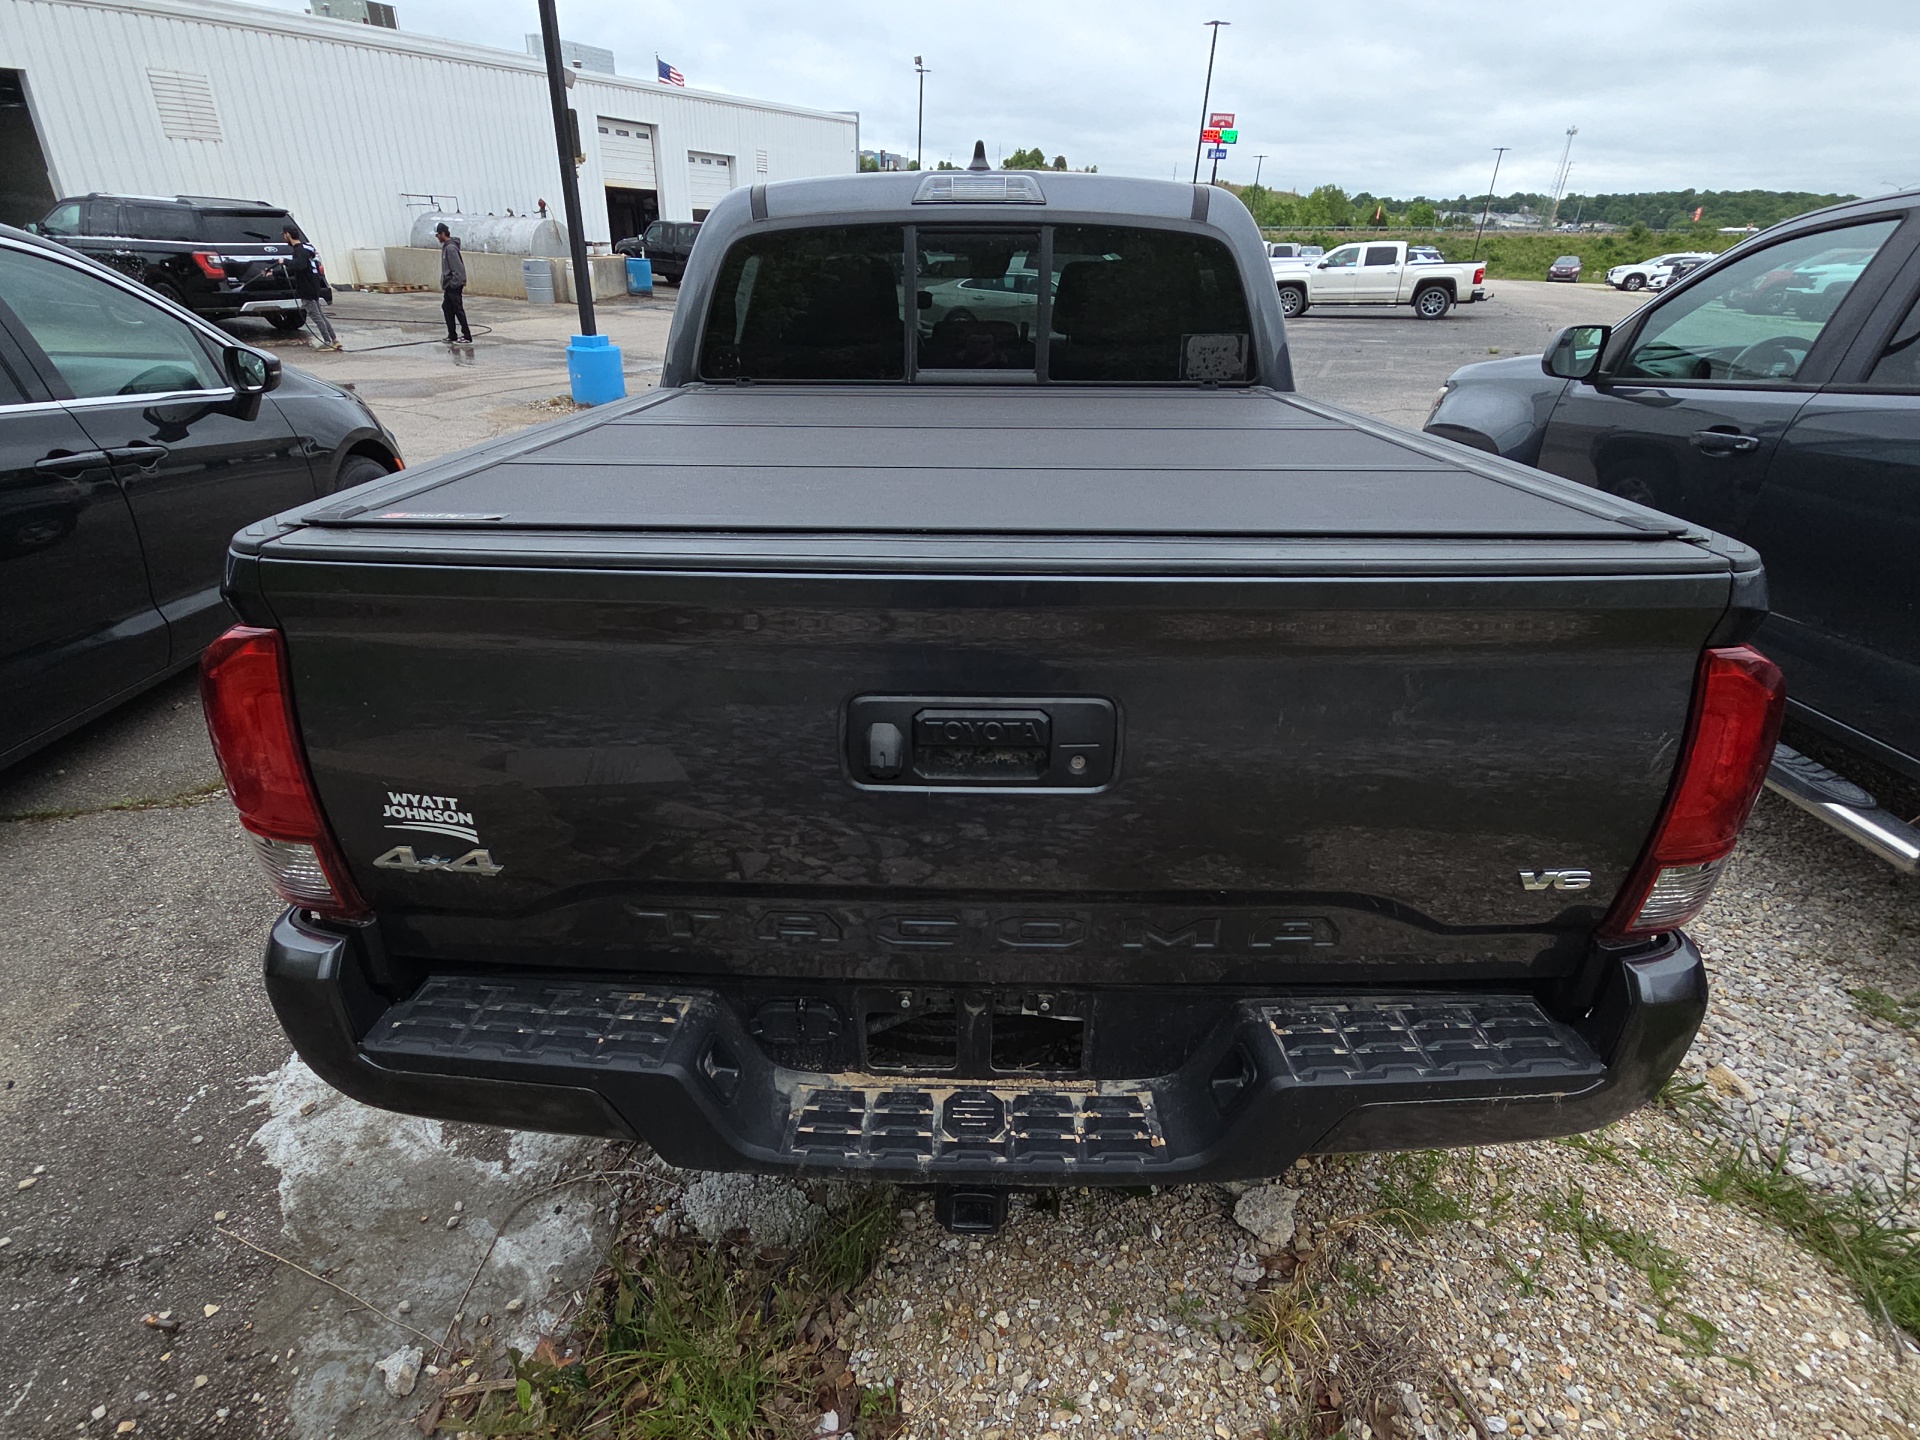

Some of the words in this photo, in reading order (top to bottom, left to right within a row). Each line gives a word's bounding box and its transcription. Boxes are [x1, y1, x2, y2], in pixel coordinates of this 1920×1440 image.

[922, 720, 1041, 744] TOYOTA
[387, 791, 458, 810] WYATT
[383, 804, 474, 825] JOHNSON
[1518, 868, 1592, 891] V6
[626, 902, 1341, 947] TACOMA
